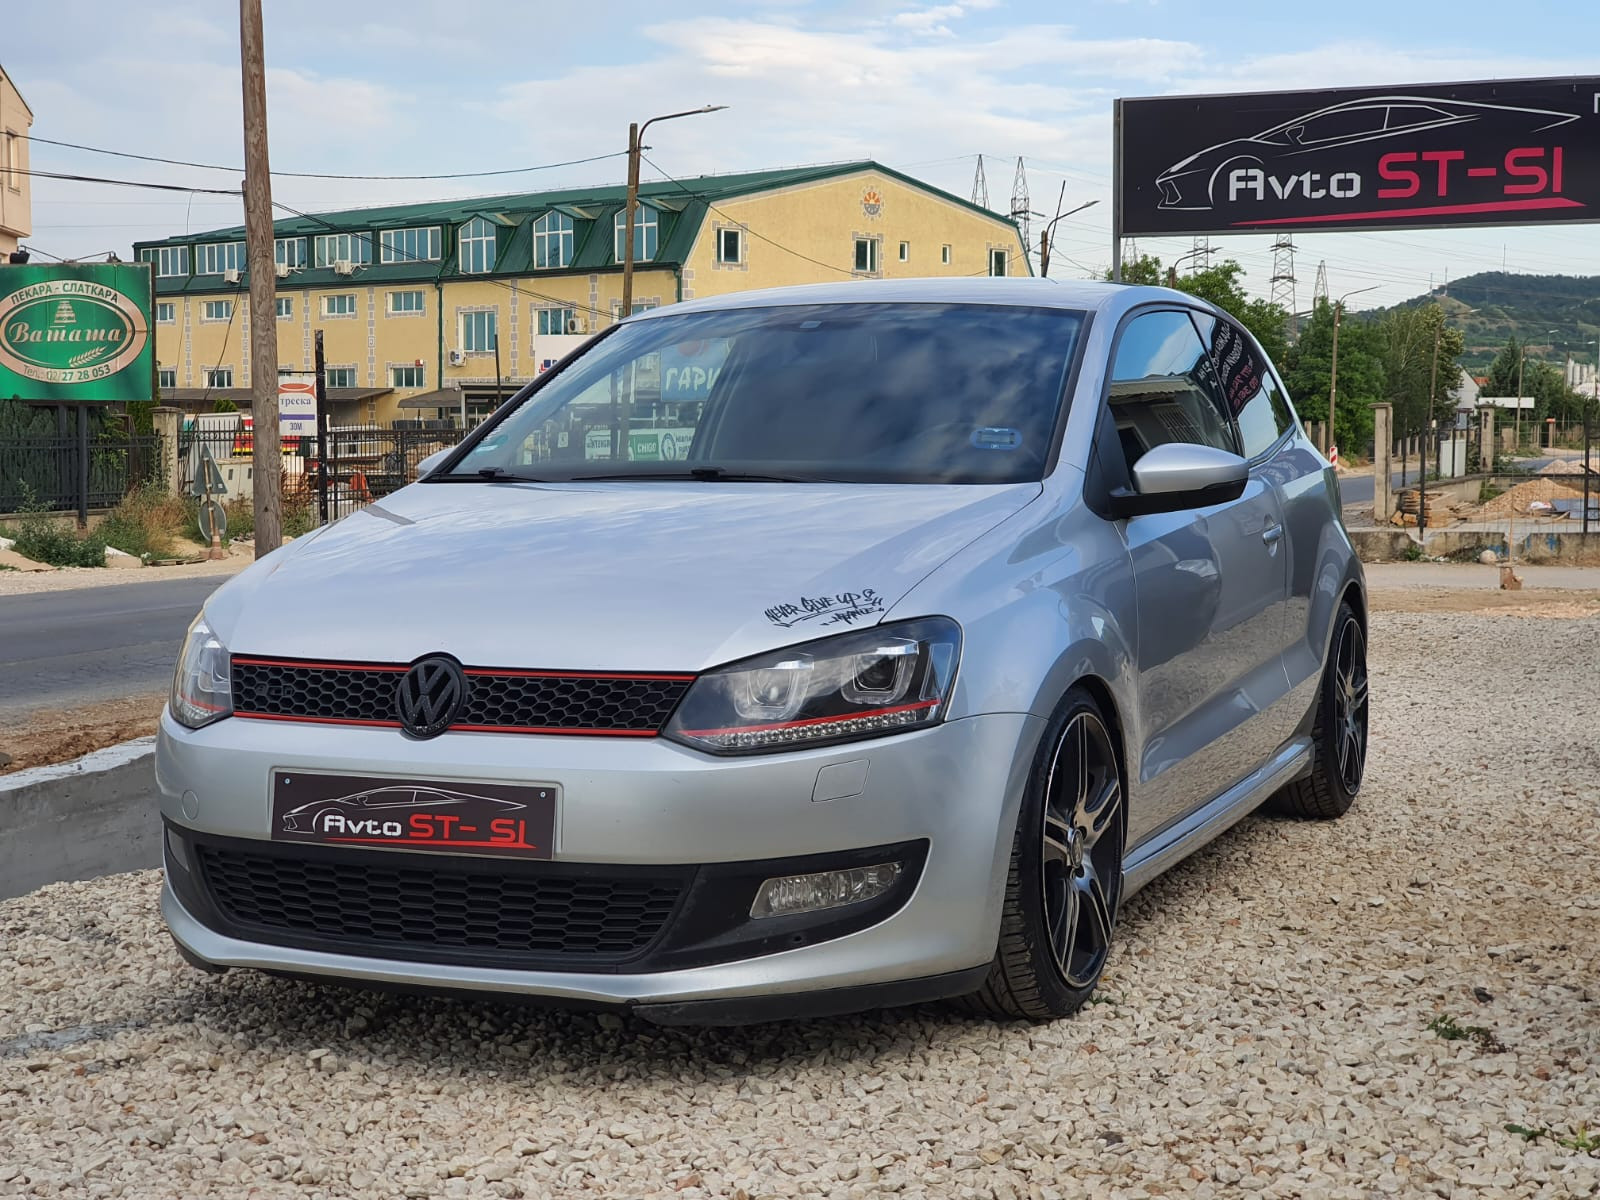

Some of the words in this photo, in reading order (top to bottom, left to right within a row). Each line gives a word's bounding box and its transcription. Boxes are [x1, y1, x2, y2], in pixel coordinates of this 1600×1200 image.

[1228, 168, 1361, 201] Avto
[1377, 147, 1563, 199] ST-SI
[11, 283, 52, 305] ПЕКАРА
[62, 282, 119, 305] СЛАТКАРА
[77, 371, 90, 381] 28
[92, 364, 111, 378] 053
[323, 814, 402, 837] Avto
